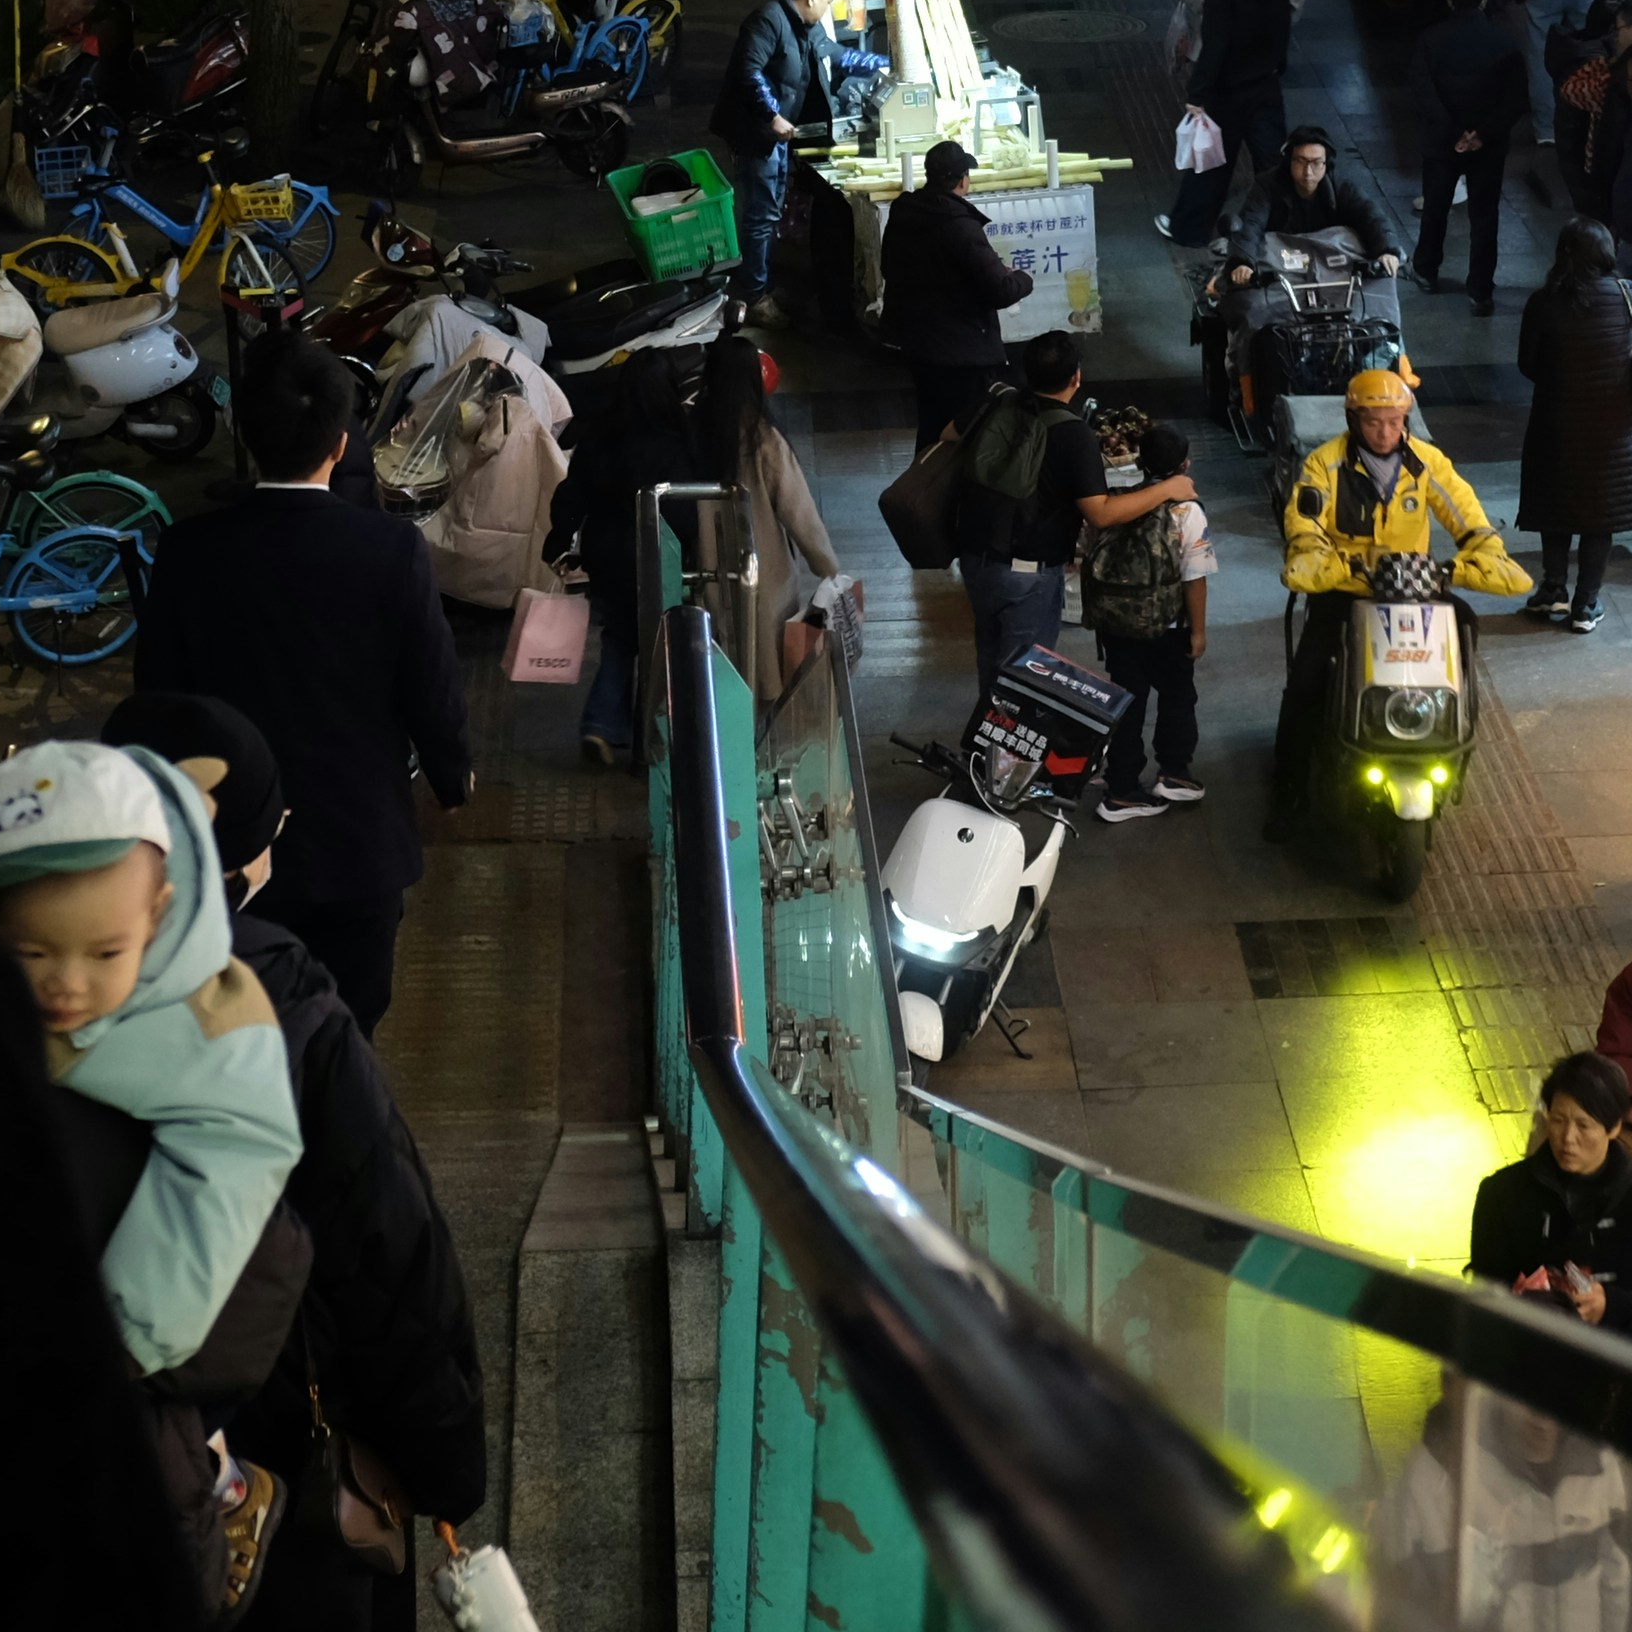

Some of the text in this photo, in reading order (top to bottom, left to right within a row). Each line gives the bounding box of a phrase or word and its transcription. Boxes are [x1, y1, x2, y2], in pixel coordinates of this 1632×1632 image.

[986, 215, 1088, 237] 那就来杯甘蔗汁
[999, 245, 1070, 274] 蔗汁
[978, 719, 1044, 762] 用顺丰同城
